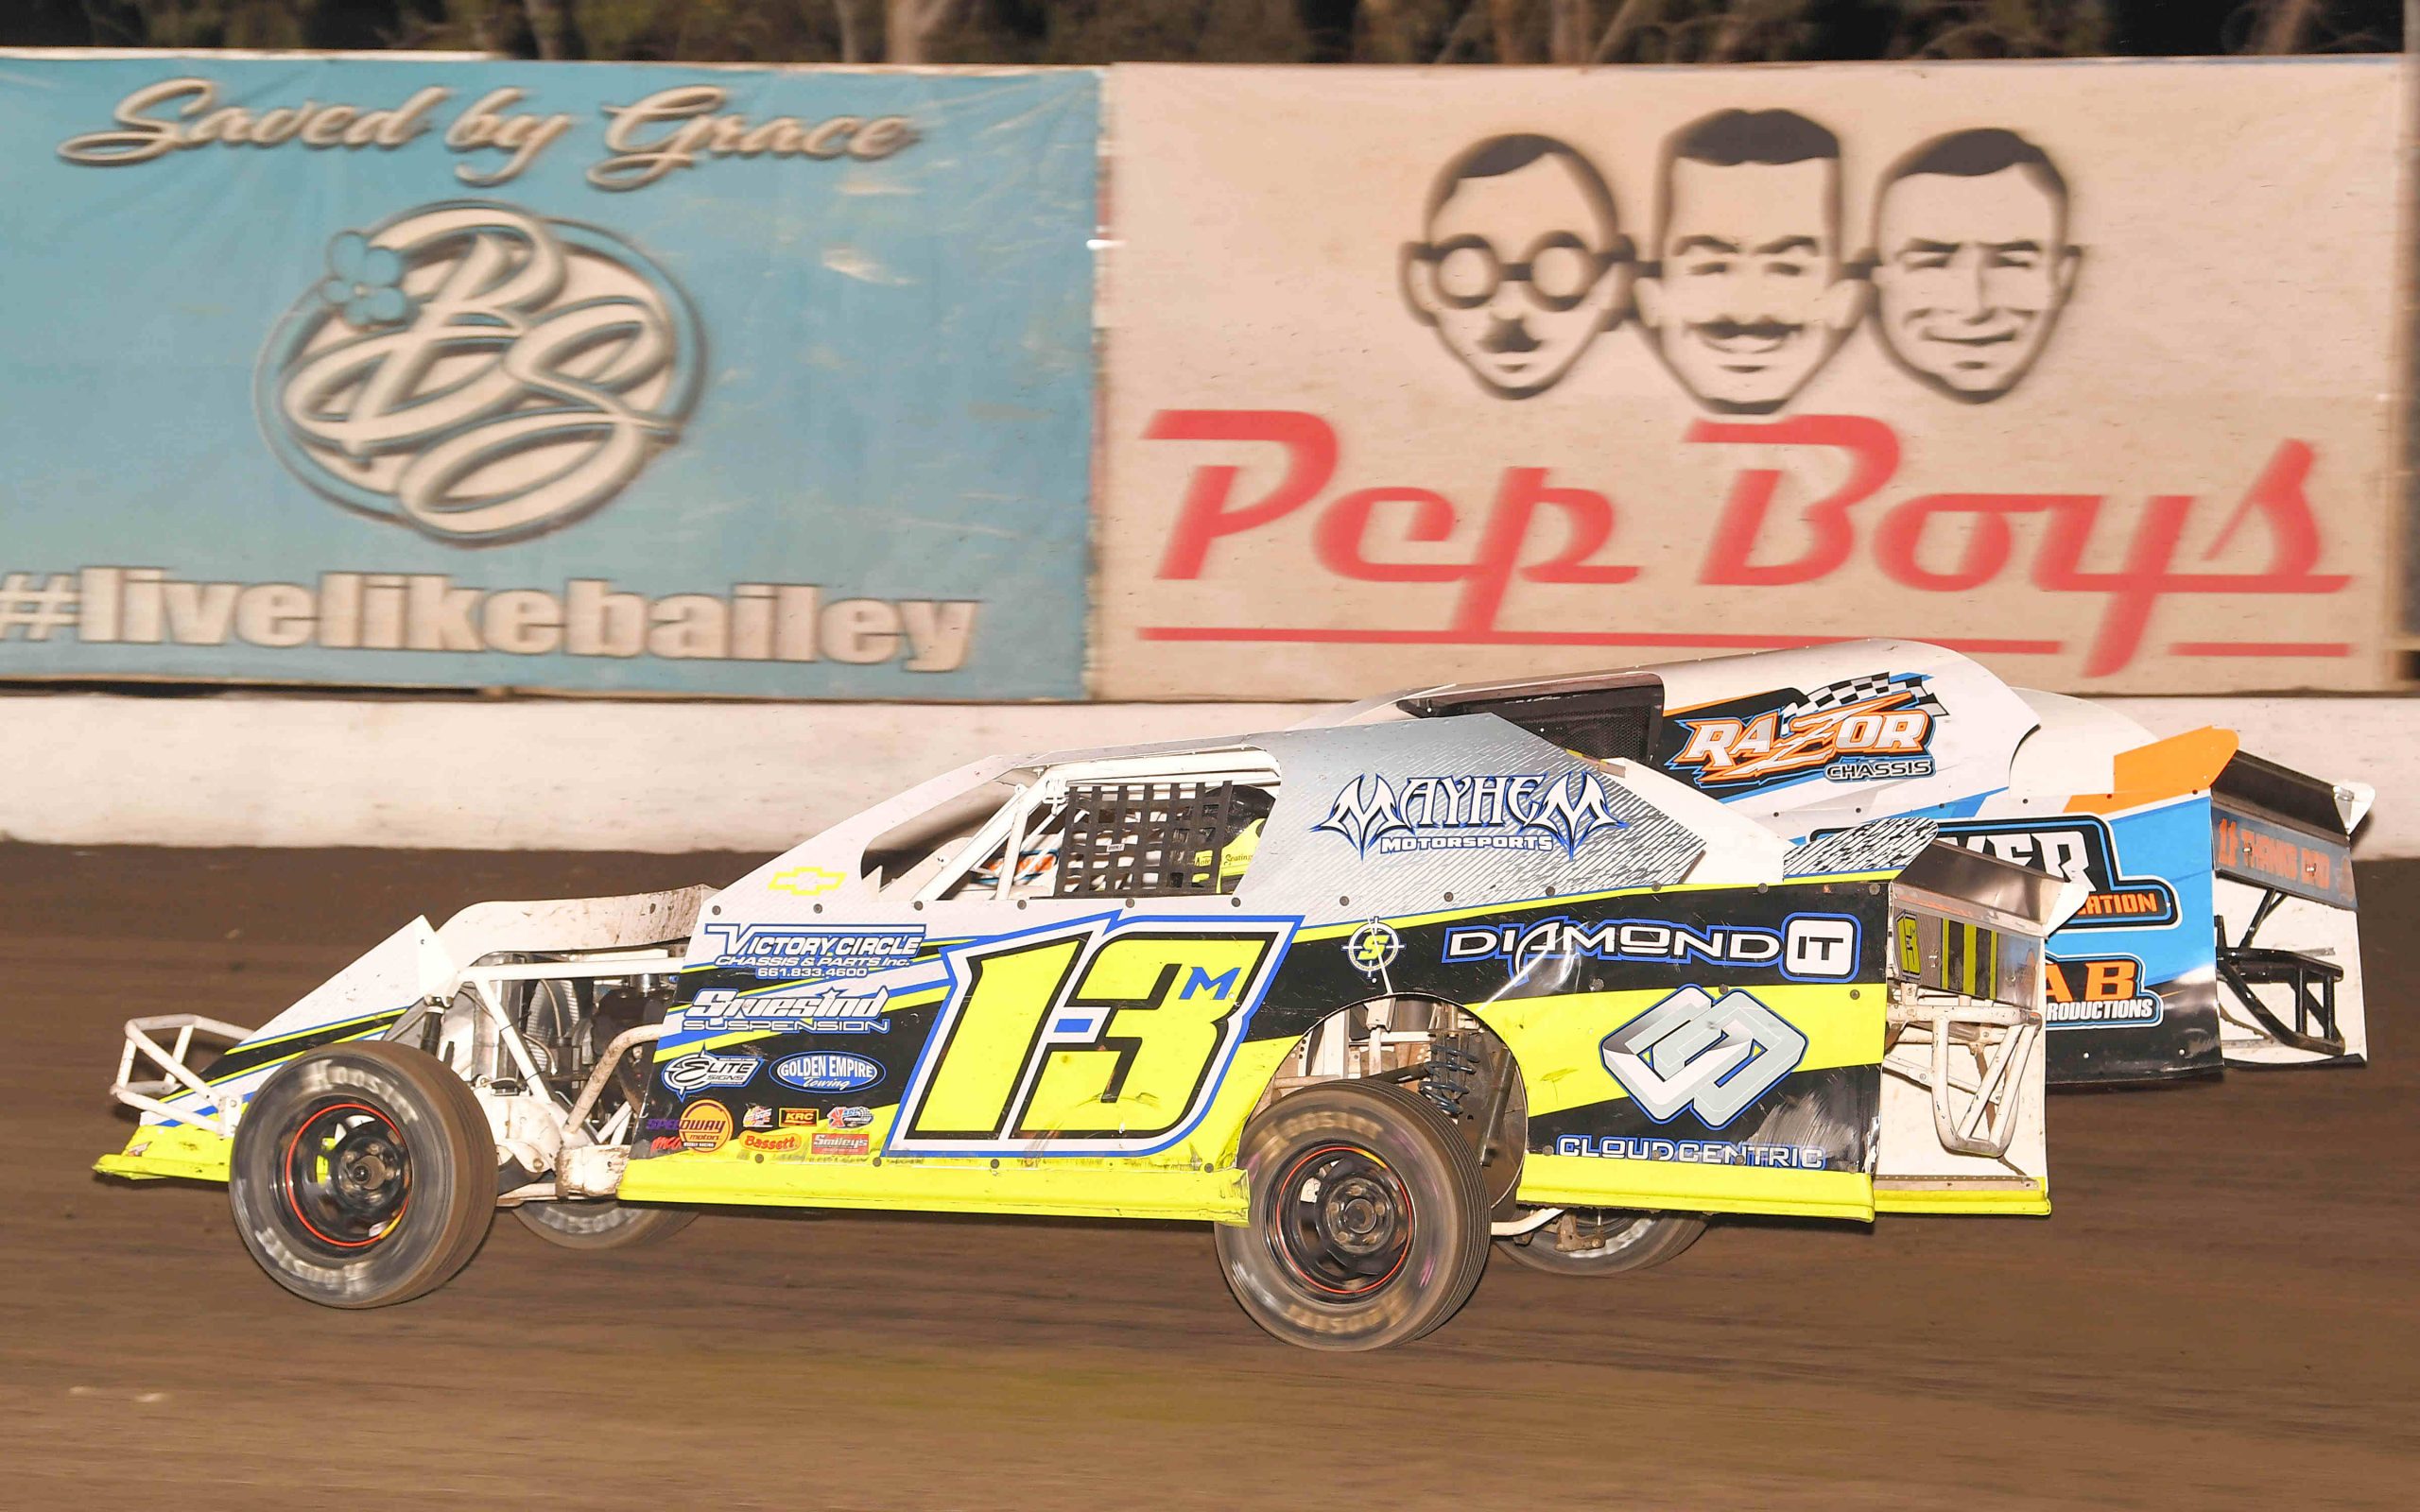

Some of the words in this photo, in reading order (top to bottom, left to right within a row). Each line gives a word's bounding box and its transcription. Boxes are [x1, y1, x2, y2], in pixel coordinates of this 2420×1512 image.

[57, 77, 453, 166] Saved
[444, 86, 571, 186] by
[586, 85, 921, 192] Grace
[1138, 408, 1643, 635] Pep
[1681, 414, 2354, 679] Boys
[0, 566, 981, 673] #livelikebailey
[1673, 692, 1932, 782] RAZOR
[1825, 759, 1934, 781] CHASSIS
[1314, 772, 1628, 857] MAYHEM
[1379, 834, 1554, 854] MOTORSPORTS
[705, 924, 836, 956] VICTORY
[835, 936, 923, 955] CIRCLE
[1447, 920, 1781, 975] DIAMOND
[1796, 934, 1846, 961] IT
[716, 955, 800, 967] CHASSIS
[801, 956, 814, 966] &
[817, 956, 881, 967] PARTS
[882, 956, 910, 967] Inc.
[757, 968, 868, 977] 661.833.4600
[2046, 998, 2153, 1022] RODUCTIONS
[683, 1020, 890, 1032] SUSPENSION
[673, 1059, 753, 1084] ELITE
[707, 1074, 745, 1082] SIGNS
[781, 1055, 827, 1077] GOLDEN
[828, 1055, 874, 1078] EMPIRE
[803, 1075, 850, 1091] Towing
[786, 1112, 815, 1121] KRC
